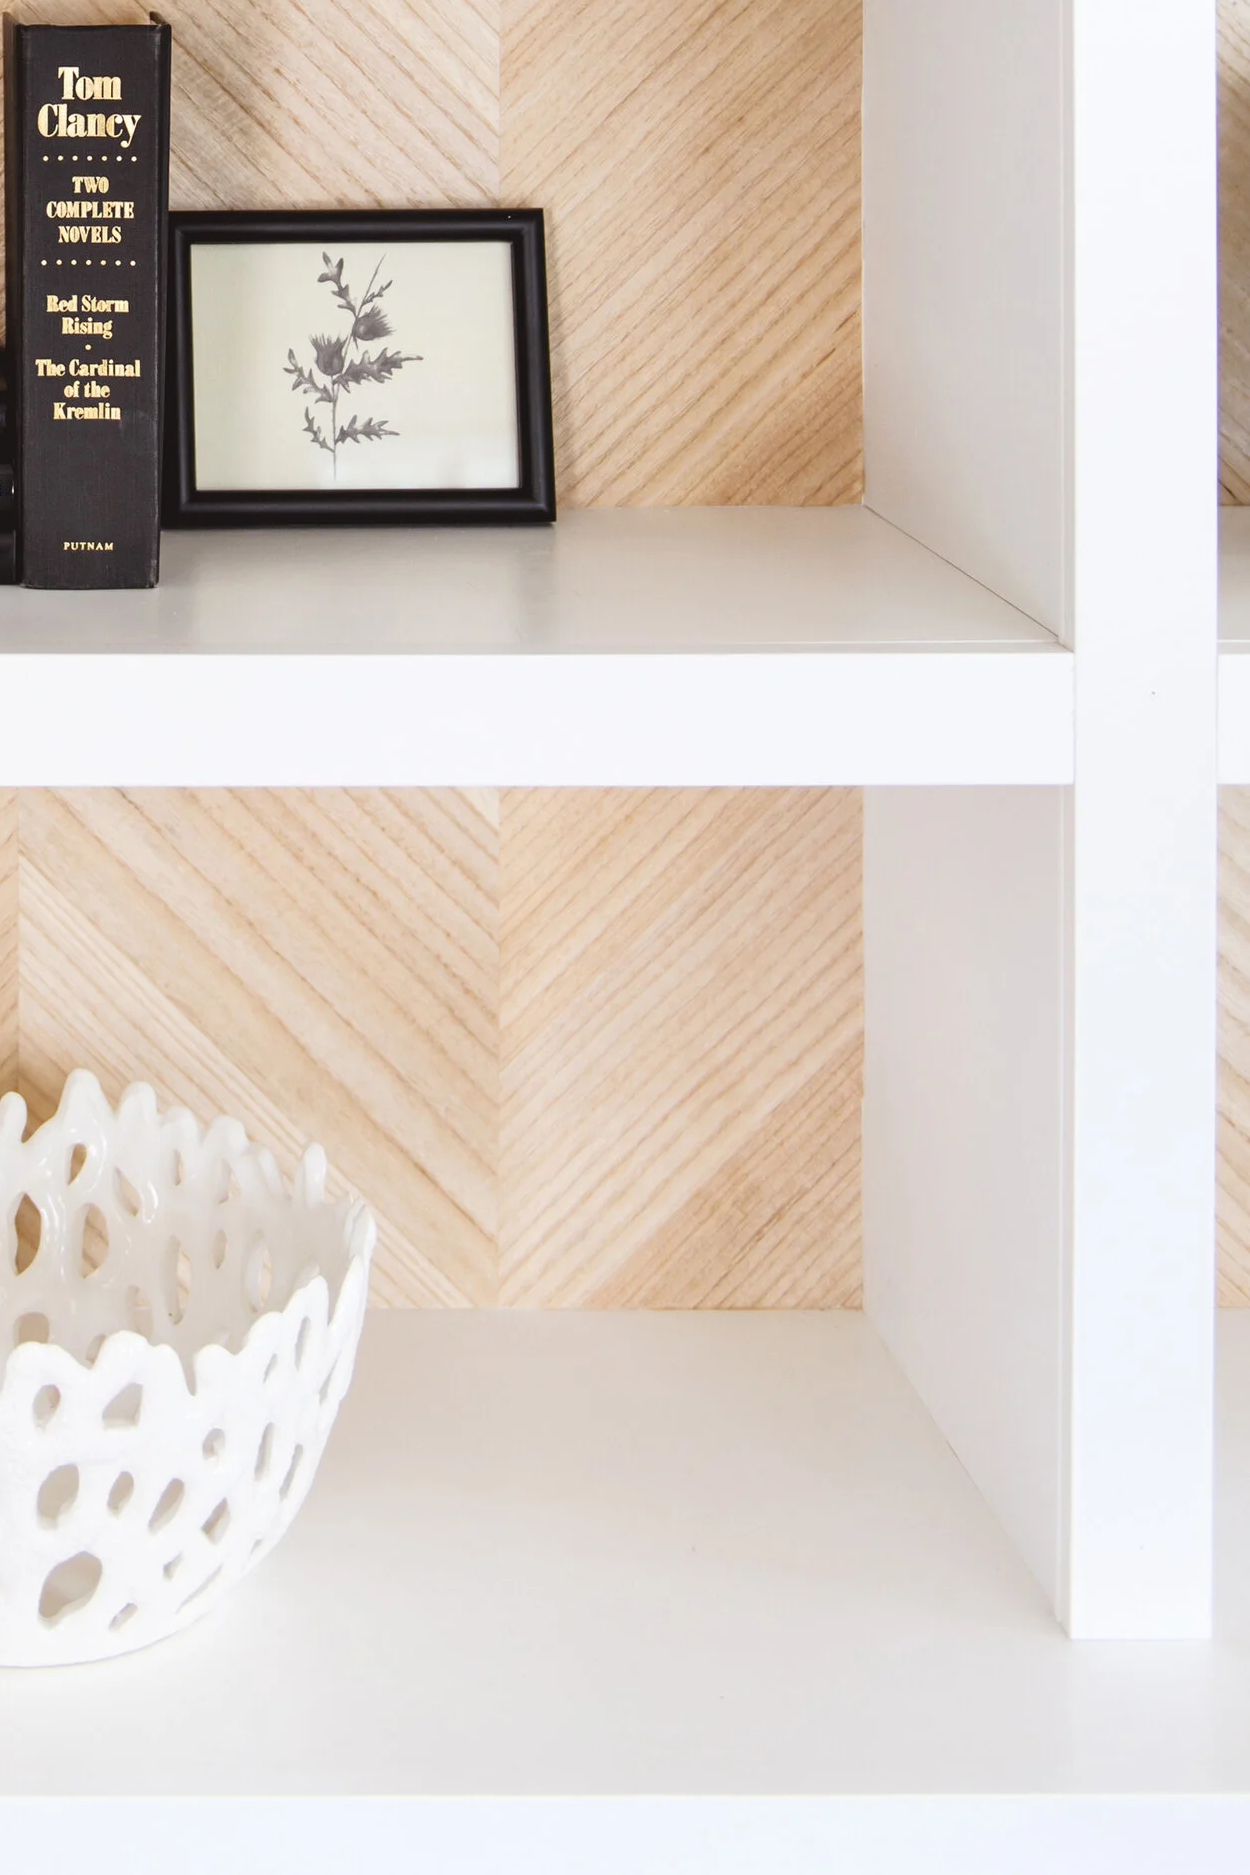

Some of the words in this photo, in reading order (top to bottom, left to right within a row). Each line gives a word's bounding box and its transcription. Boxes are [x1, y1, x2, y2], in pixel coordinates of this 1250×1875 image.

[57, 66, 122, 100] Tom
[37, 103, 142, 148] Clancy
[72, 176, 109, 193] TWO
[46, 201, 134, 219] COMPLETE
[58, 225, 122, 243] NOVELS
[46, 294, 78, 312] Red
[81, 294, 129, 313] Storm
[62, 317, 113, 339] Rising
[35, 359, 65, 376] The
[69, 359, 141, 377] Cardinal
[63, 380, 80, 398] of
[84, 380, 110, 398] the
[53, 402, 121, 420] Kremlin
[63, 541, 114, 551] PUTNAM
